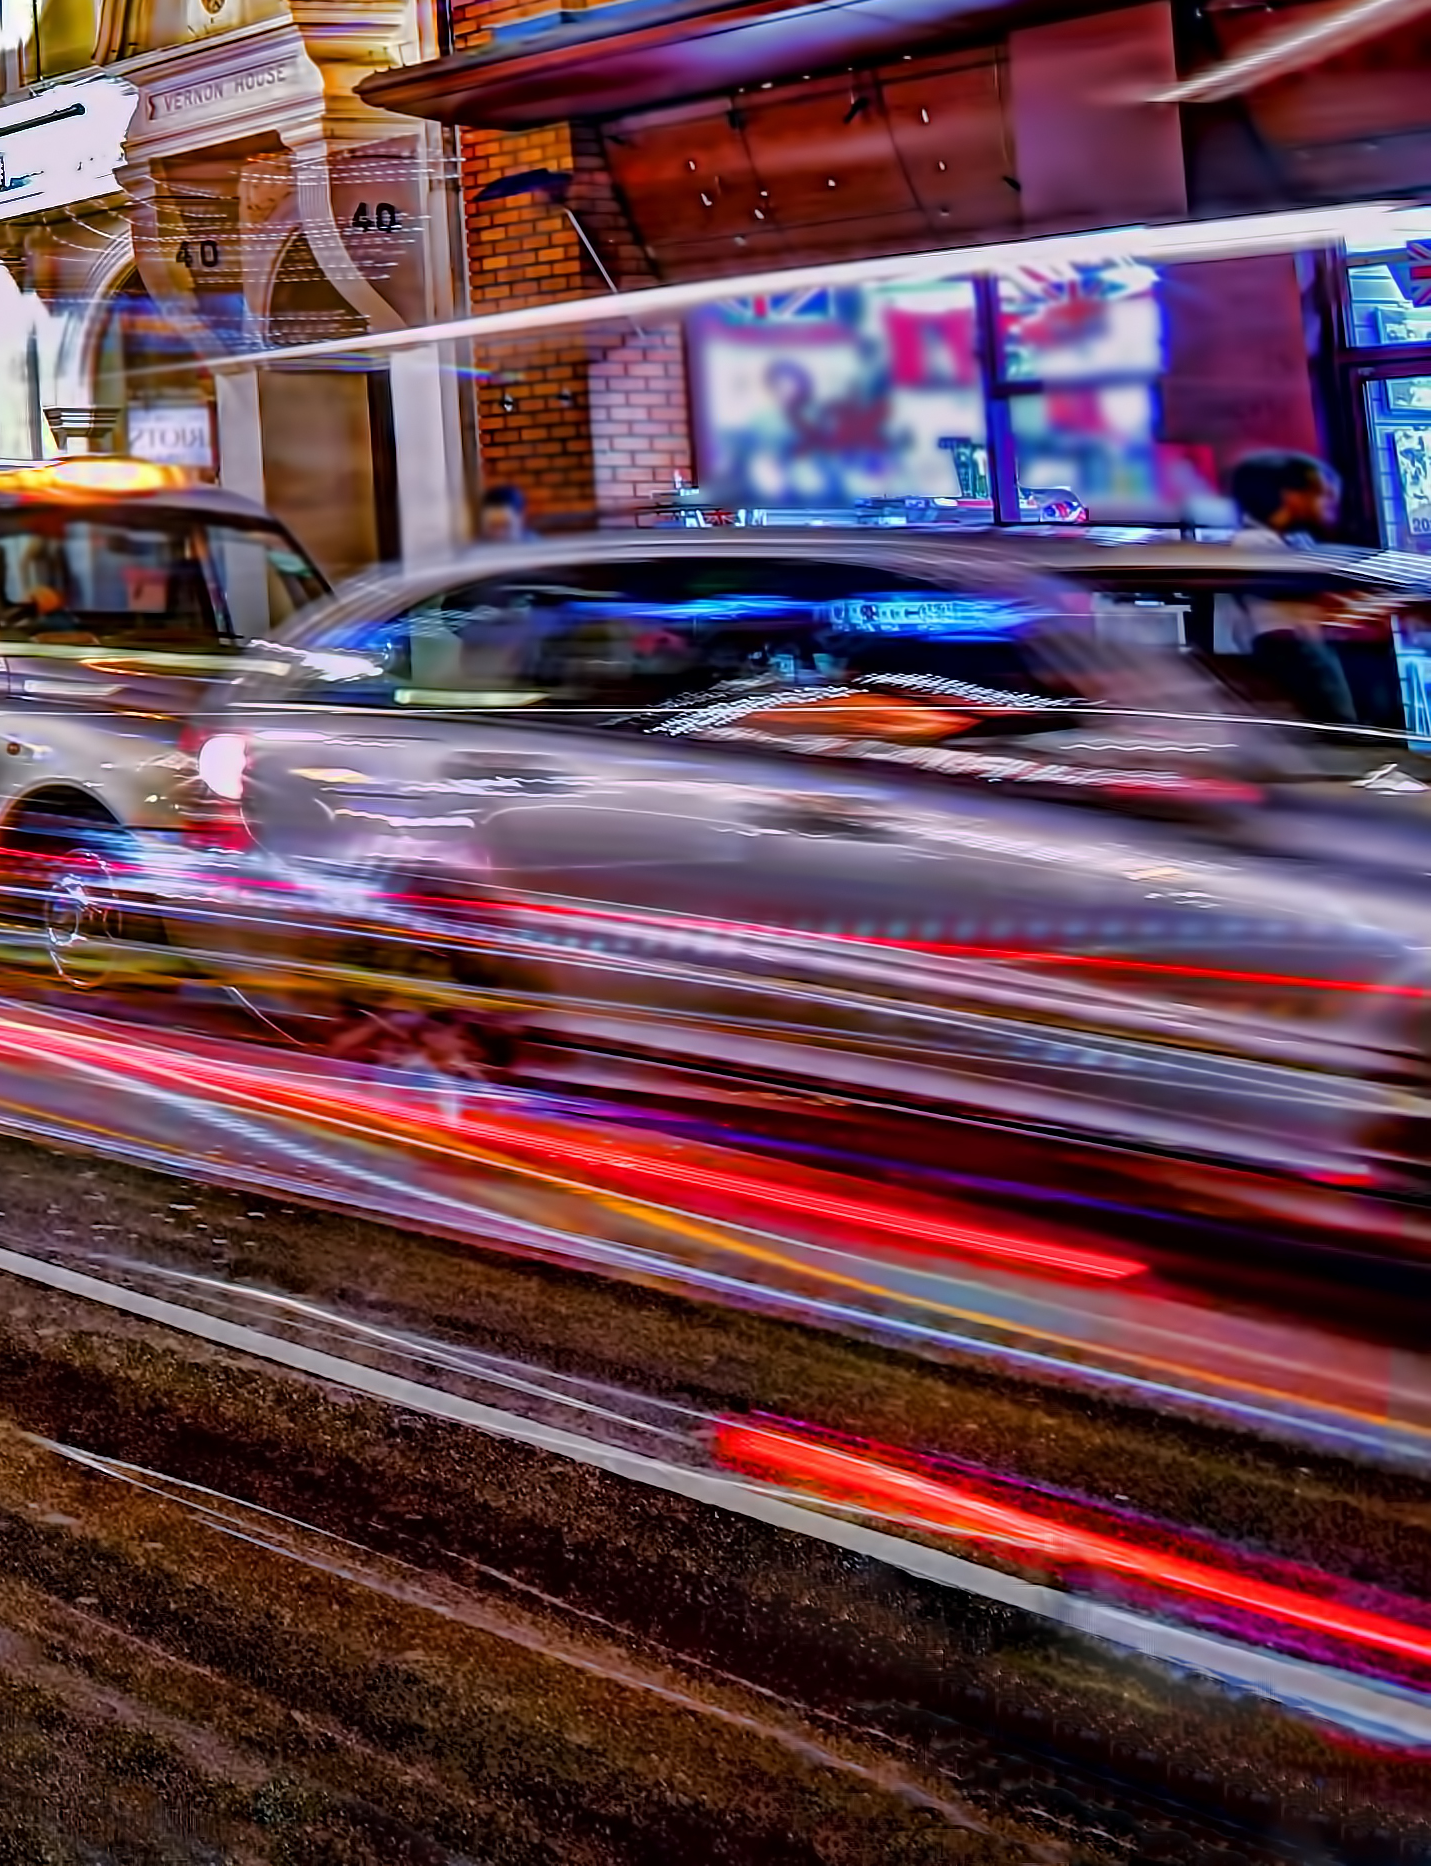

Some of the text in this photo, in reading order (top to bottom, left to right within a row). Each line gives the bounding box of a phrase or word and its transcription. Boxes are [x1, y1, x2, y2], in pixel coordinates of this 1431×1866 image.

[164, 65, 287, 112] VERNON HOUSE
[352, 201, 400, 233] 40
[176, 240, 219, 268] 40
